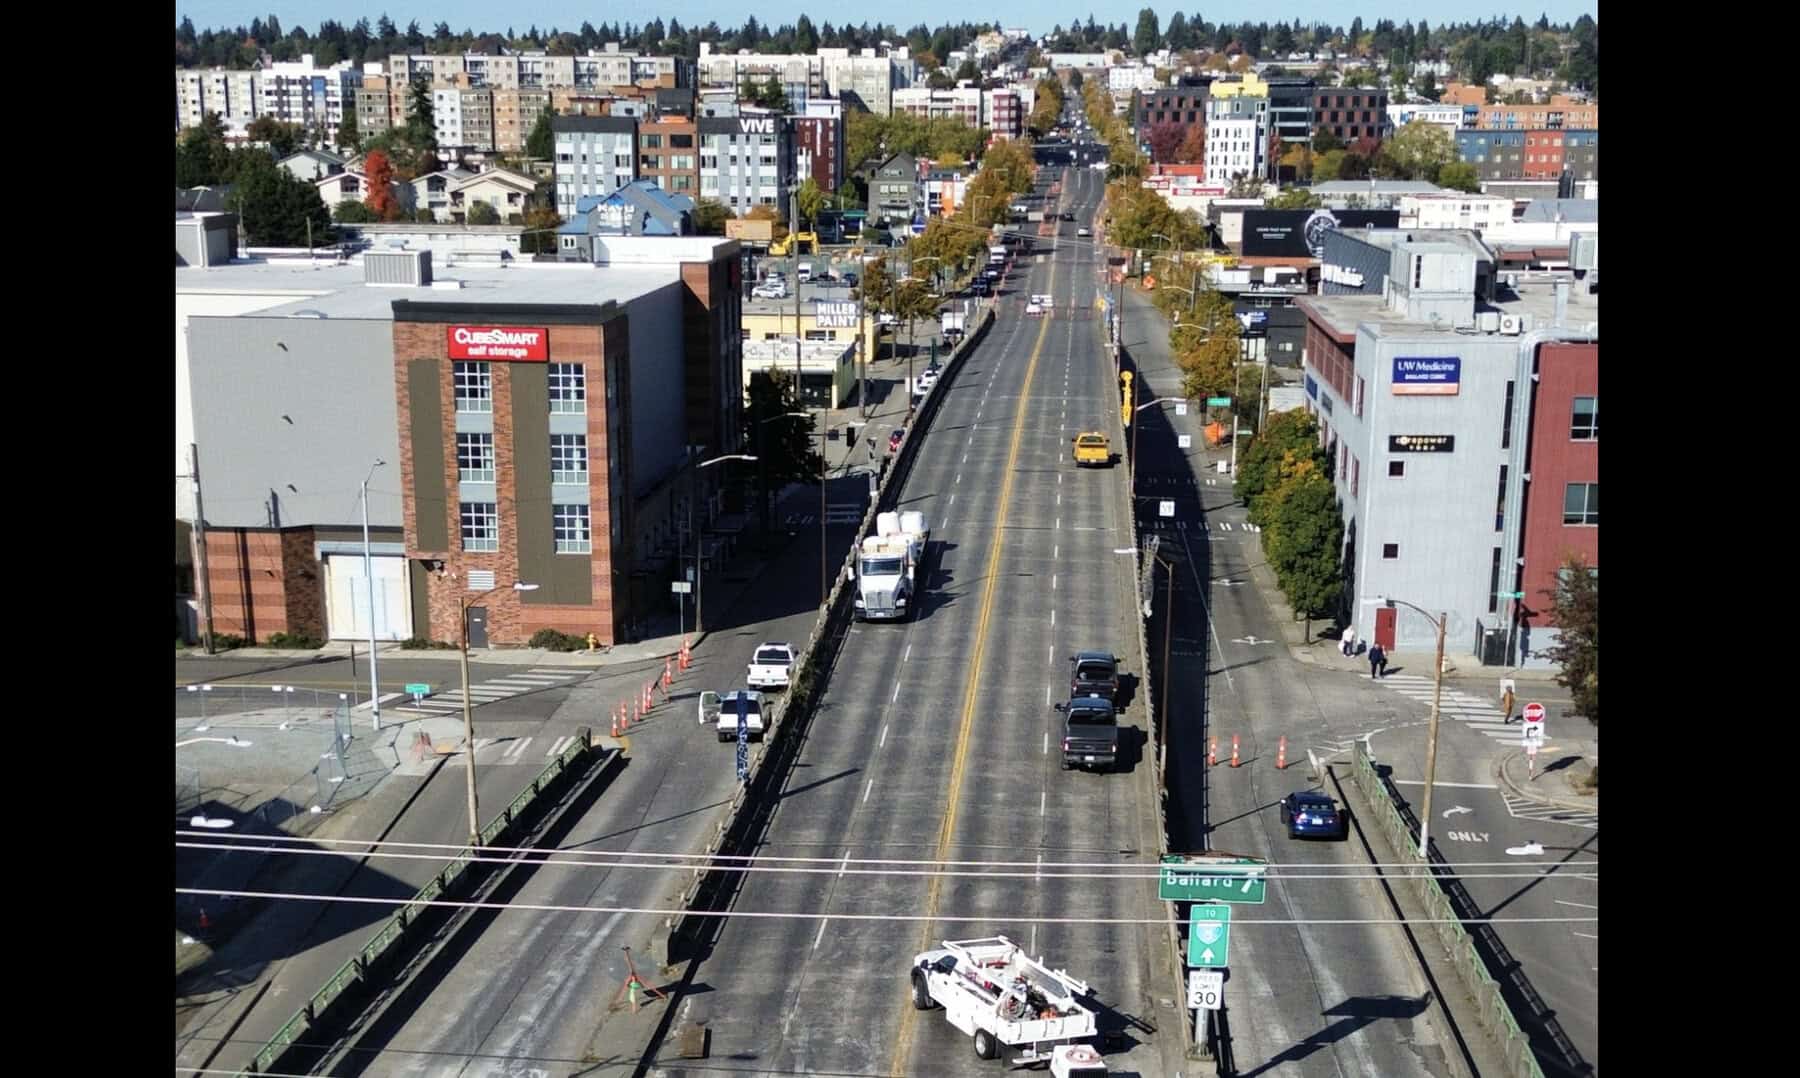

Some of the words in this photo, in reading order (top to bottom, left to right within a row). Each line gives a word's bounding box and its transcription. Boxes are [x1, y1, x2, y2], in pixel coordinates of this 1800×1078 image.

[740, 119, 774, 133] VIVE
[817, 303, 856, 315] MILLER
[817, 315, 855, 327] PAINT
[467, 346, 486, 356] self
[488, 347, 528, 358] storage
[1398, 361, 1416, 371] UW
[1416, 361, 1455, 371] Medicine
[1448, 831, 1489, 842] ONLY
[1166, 870, 1233, 888] Ballard
[1193, 991, 1217, 1005] 30
